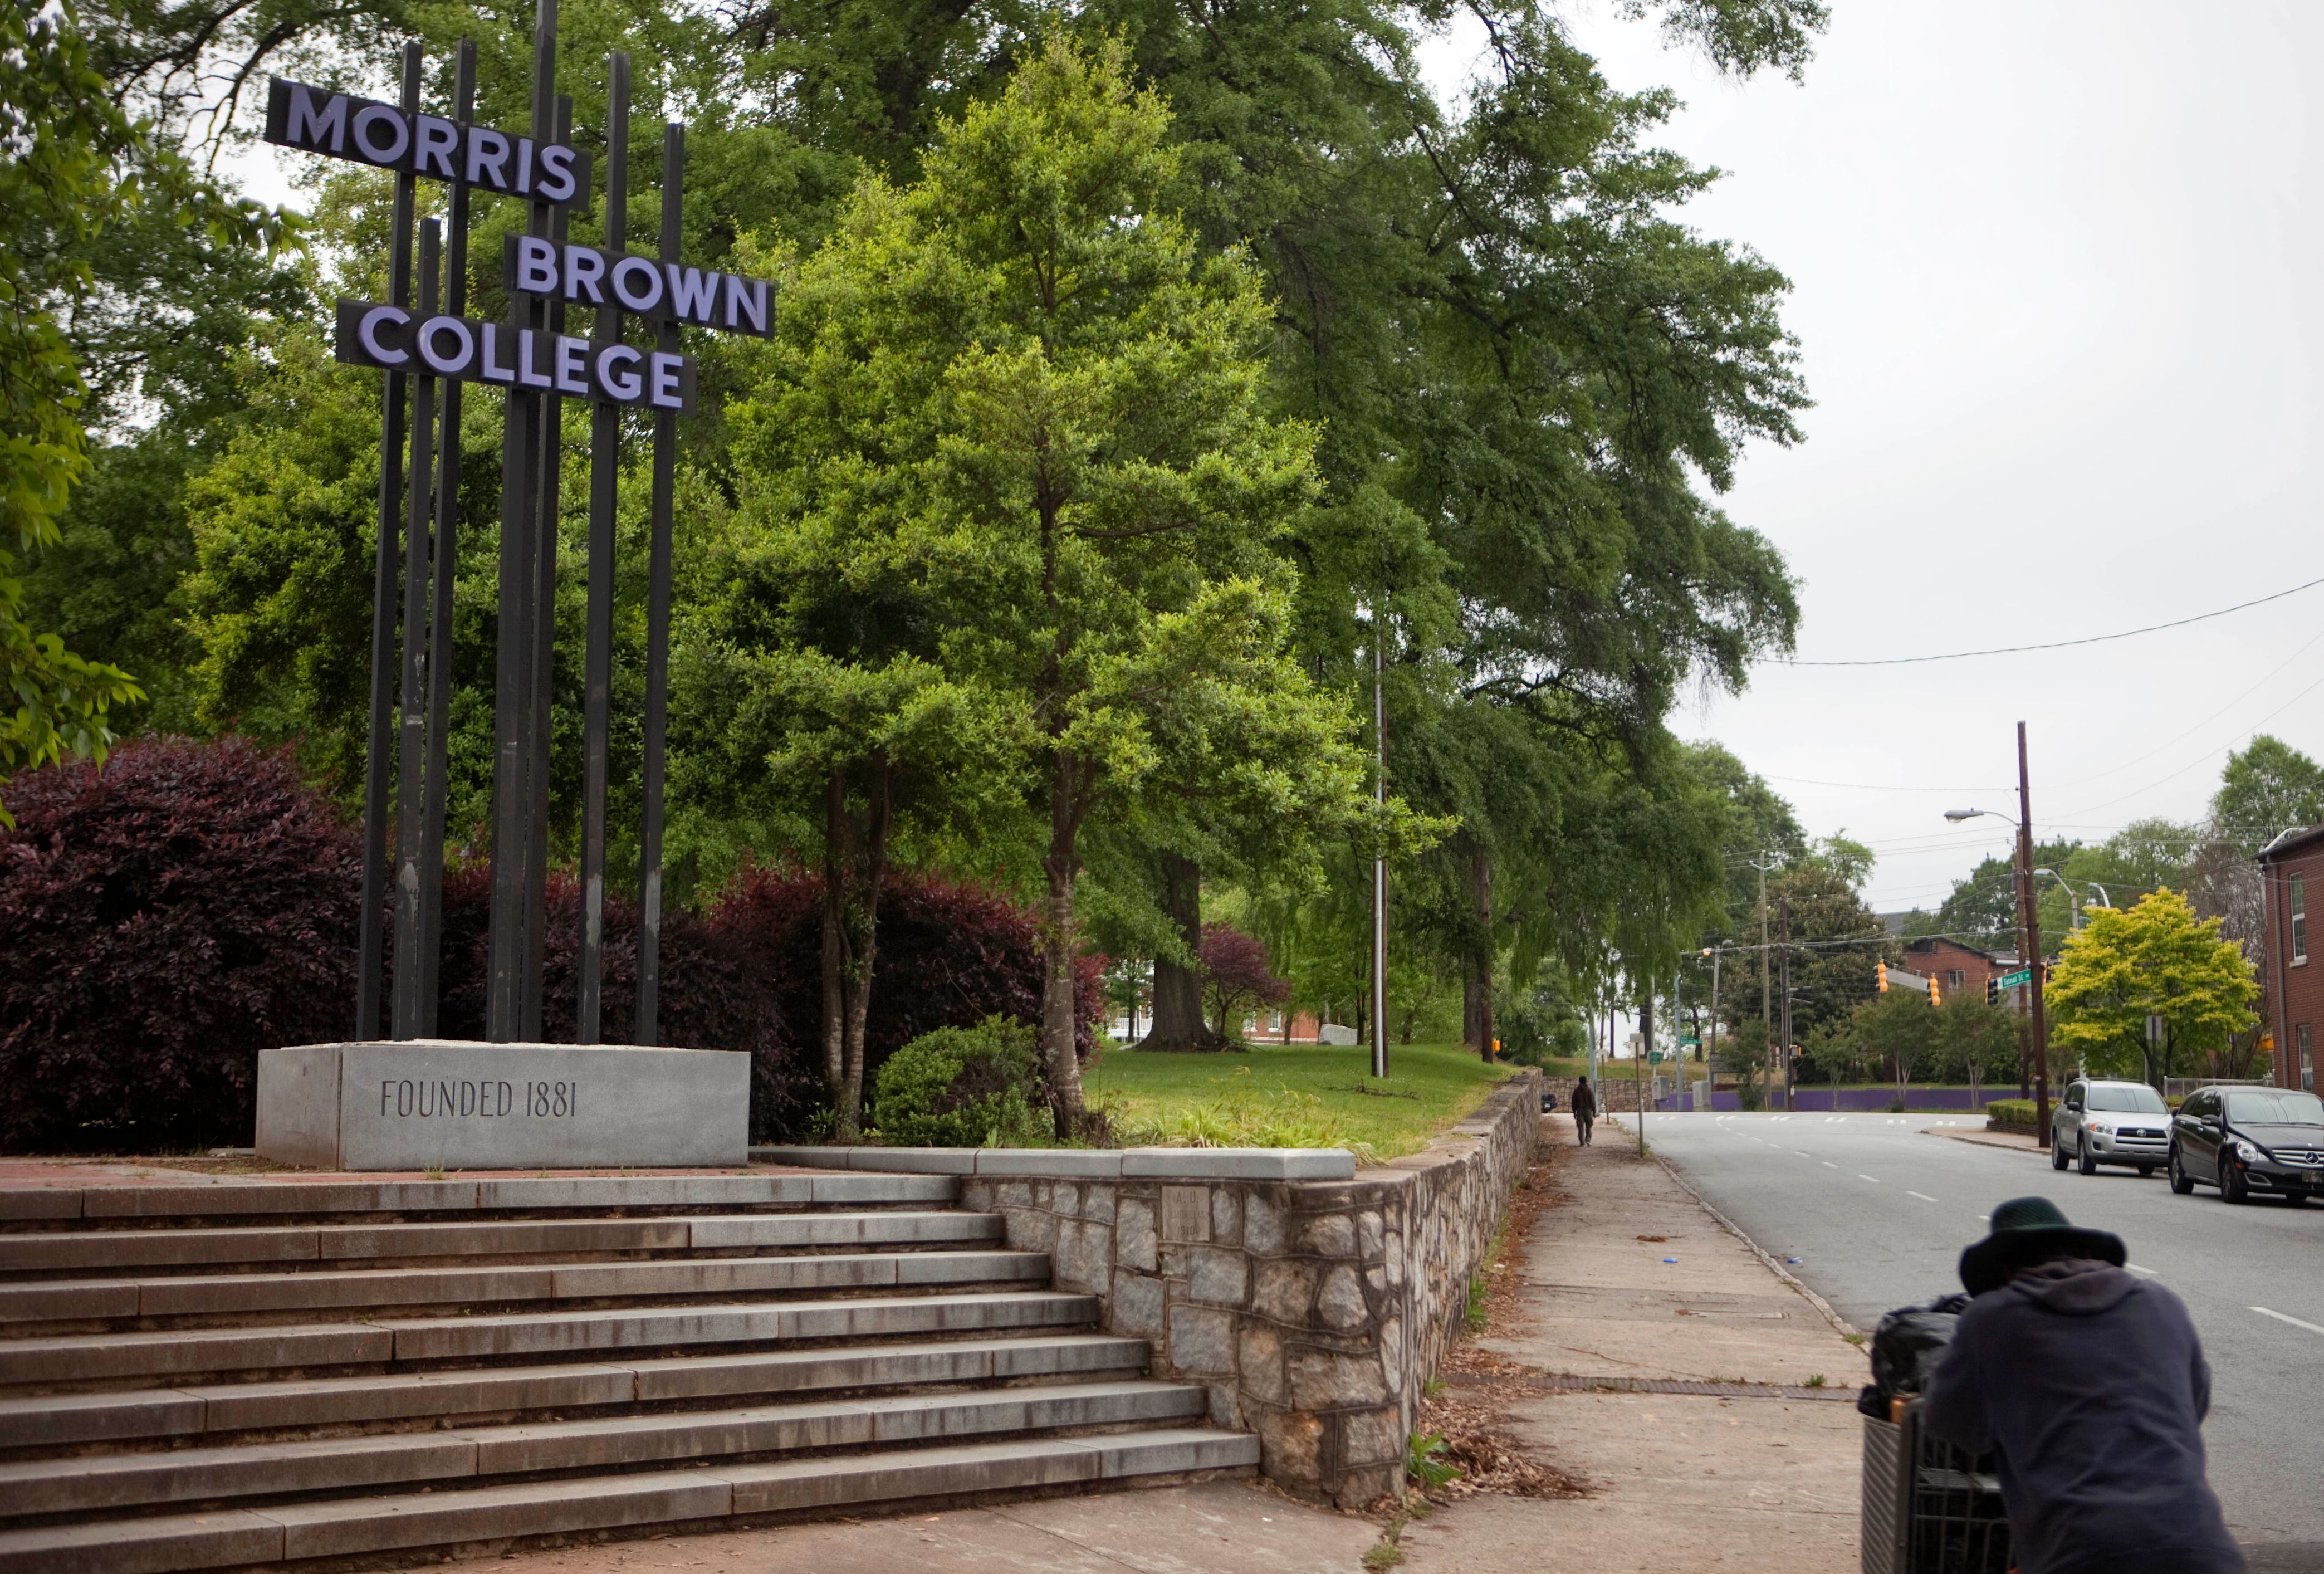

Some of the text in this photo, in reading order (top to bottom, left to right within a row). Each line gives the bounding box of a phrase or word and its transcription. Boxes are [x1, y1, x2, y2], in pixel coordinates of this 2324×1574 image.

[286, 85, 576, 201] MORRIS
[517, 235, 767, 333] BROWN
[358, 305, 683, 408] COLLEGE
[381, 1079, 576, 1117] FOUNDED 1881
[1176, 1191, 1198, 1203] A. U.
